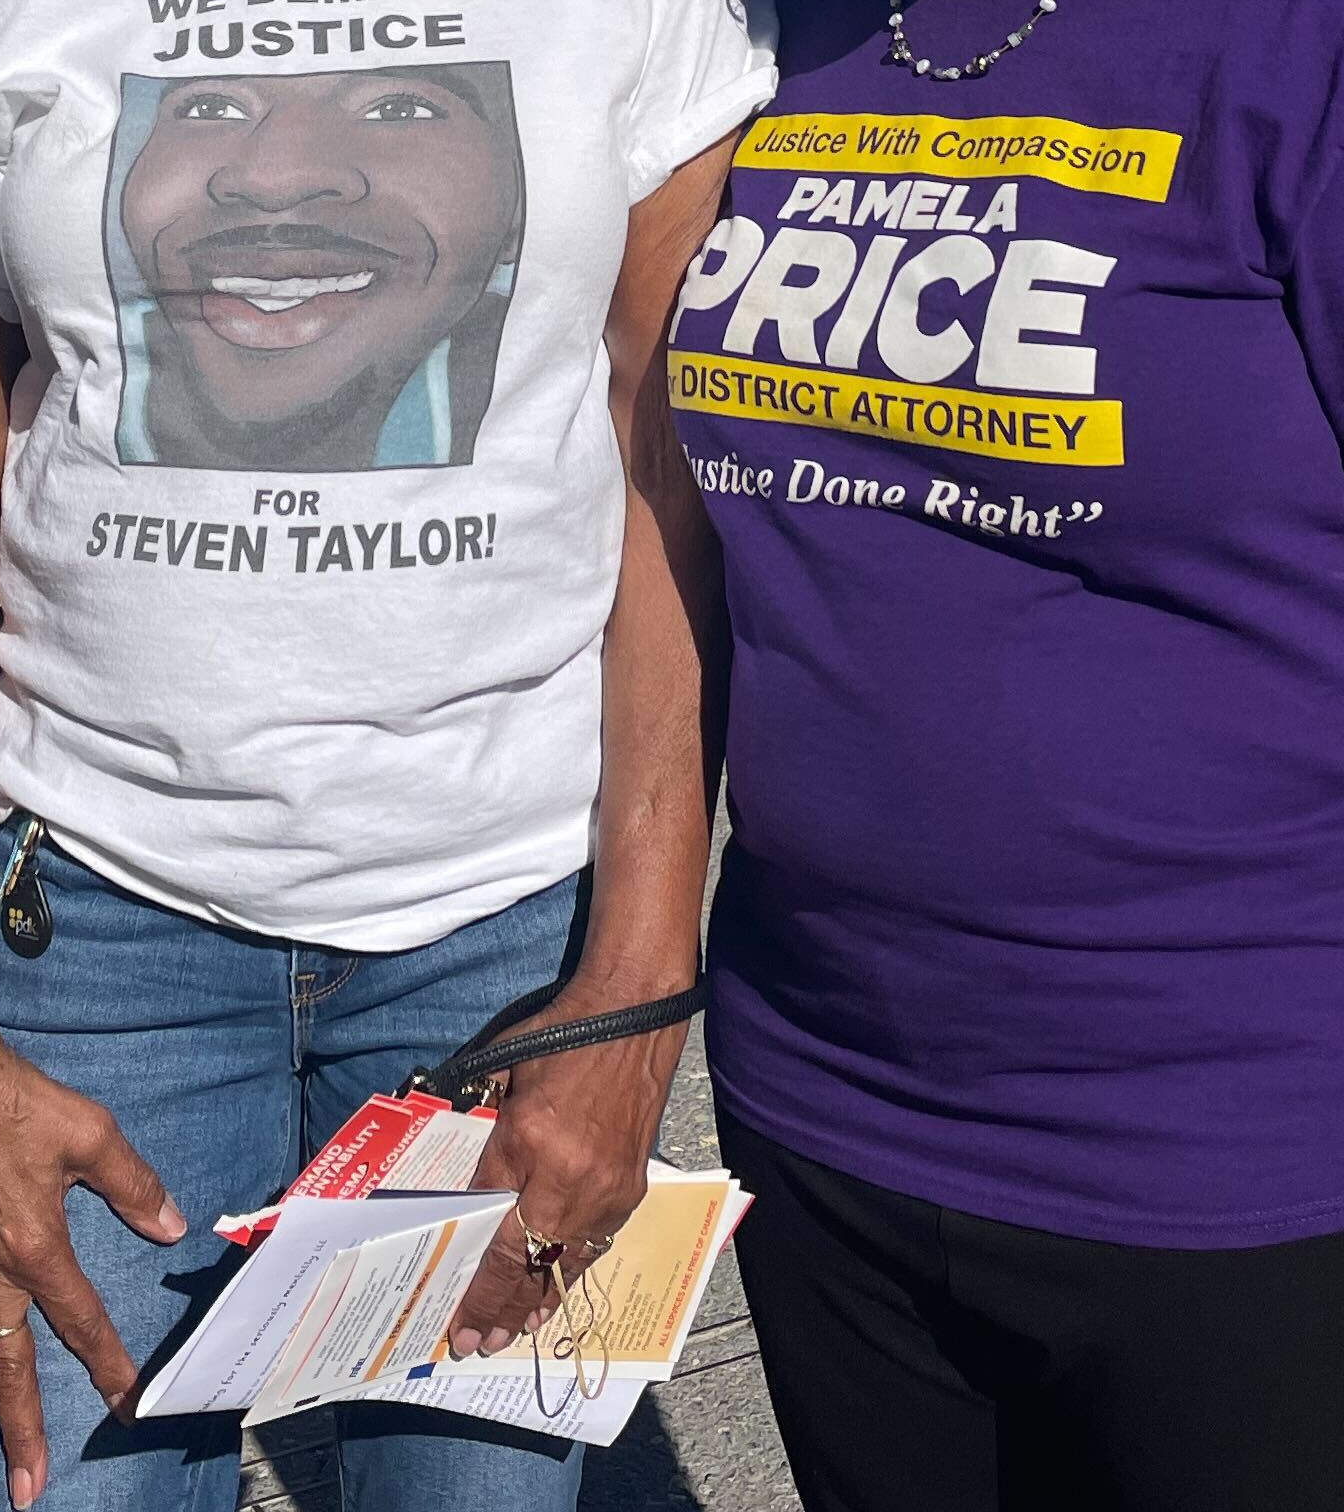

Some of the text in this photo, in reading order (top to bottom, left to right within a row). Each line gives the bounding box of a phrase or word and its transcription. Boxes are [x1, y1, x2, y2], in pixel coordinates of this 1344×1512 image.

[153, 14, 466, 62] JUSTICE
[754, 124, 1148, 176] Justice With Compassion
[776, 176, 1019, 233] PAMELA
[668, 215, 1119, 395] PRICE
[681, 364, 840, 419] DISTRICT
[850, 392, 1087, 451] ATTORNEY
[253, 489, 321, 516] FOR
[682, 443, 774, 499] ustice
[785, 458, 906, 510] Done
[86, 512, 497, 573] STEVEN TAYLOR!
[355, 1114, 430, 1199] CITY COUNCIL
